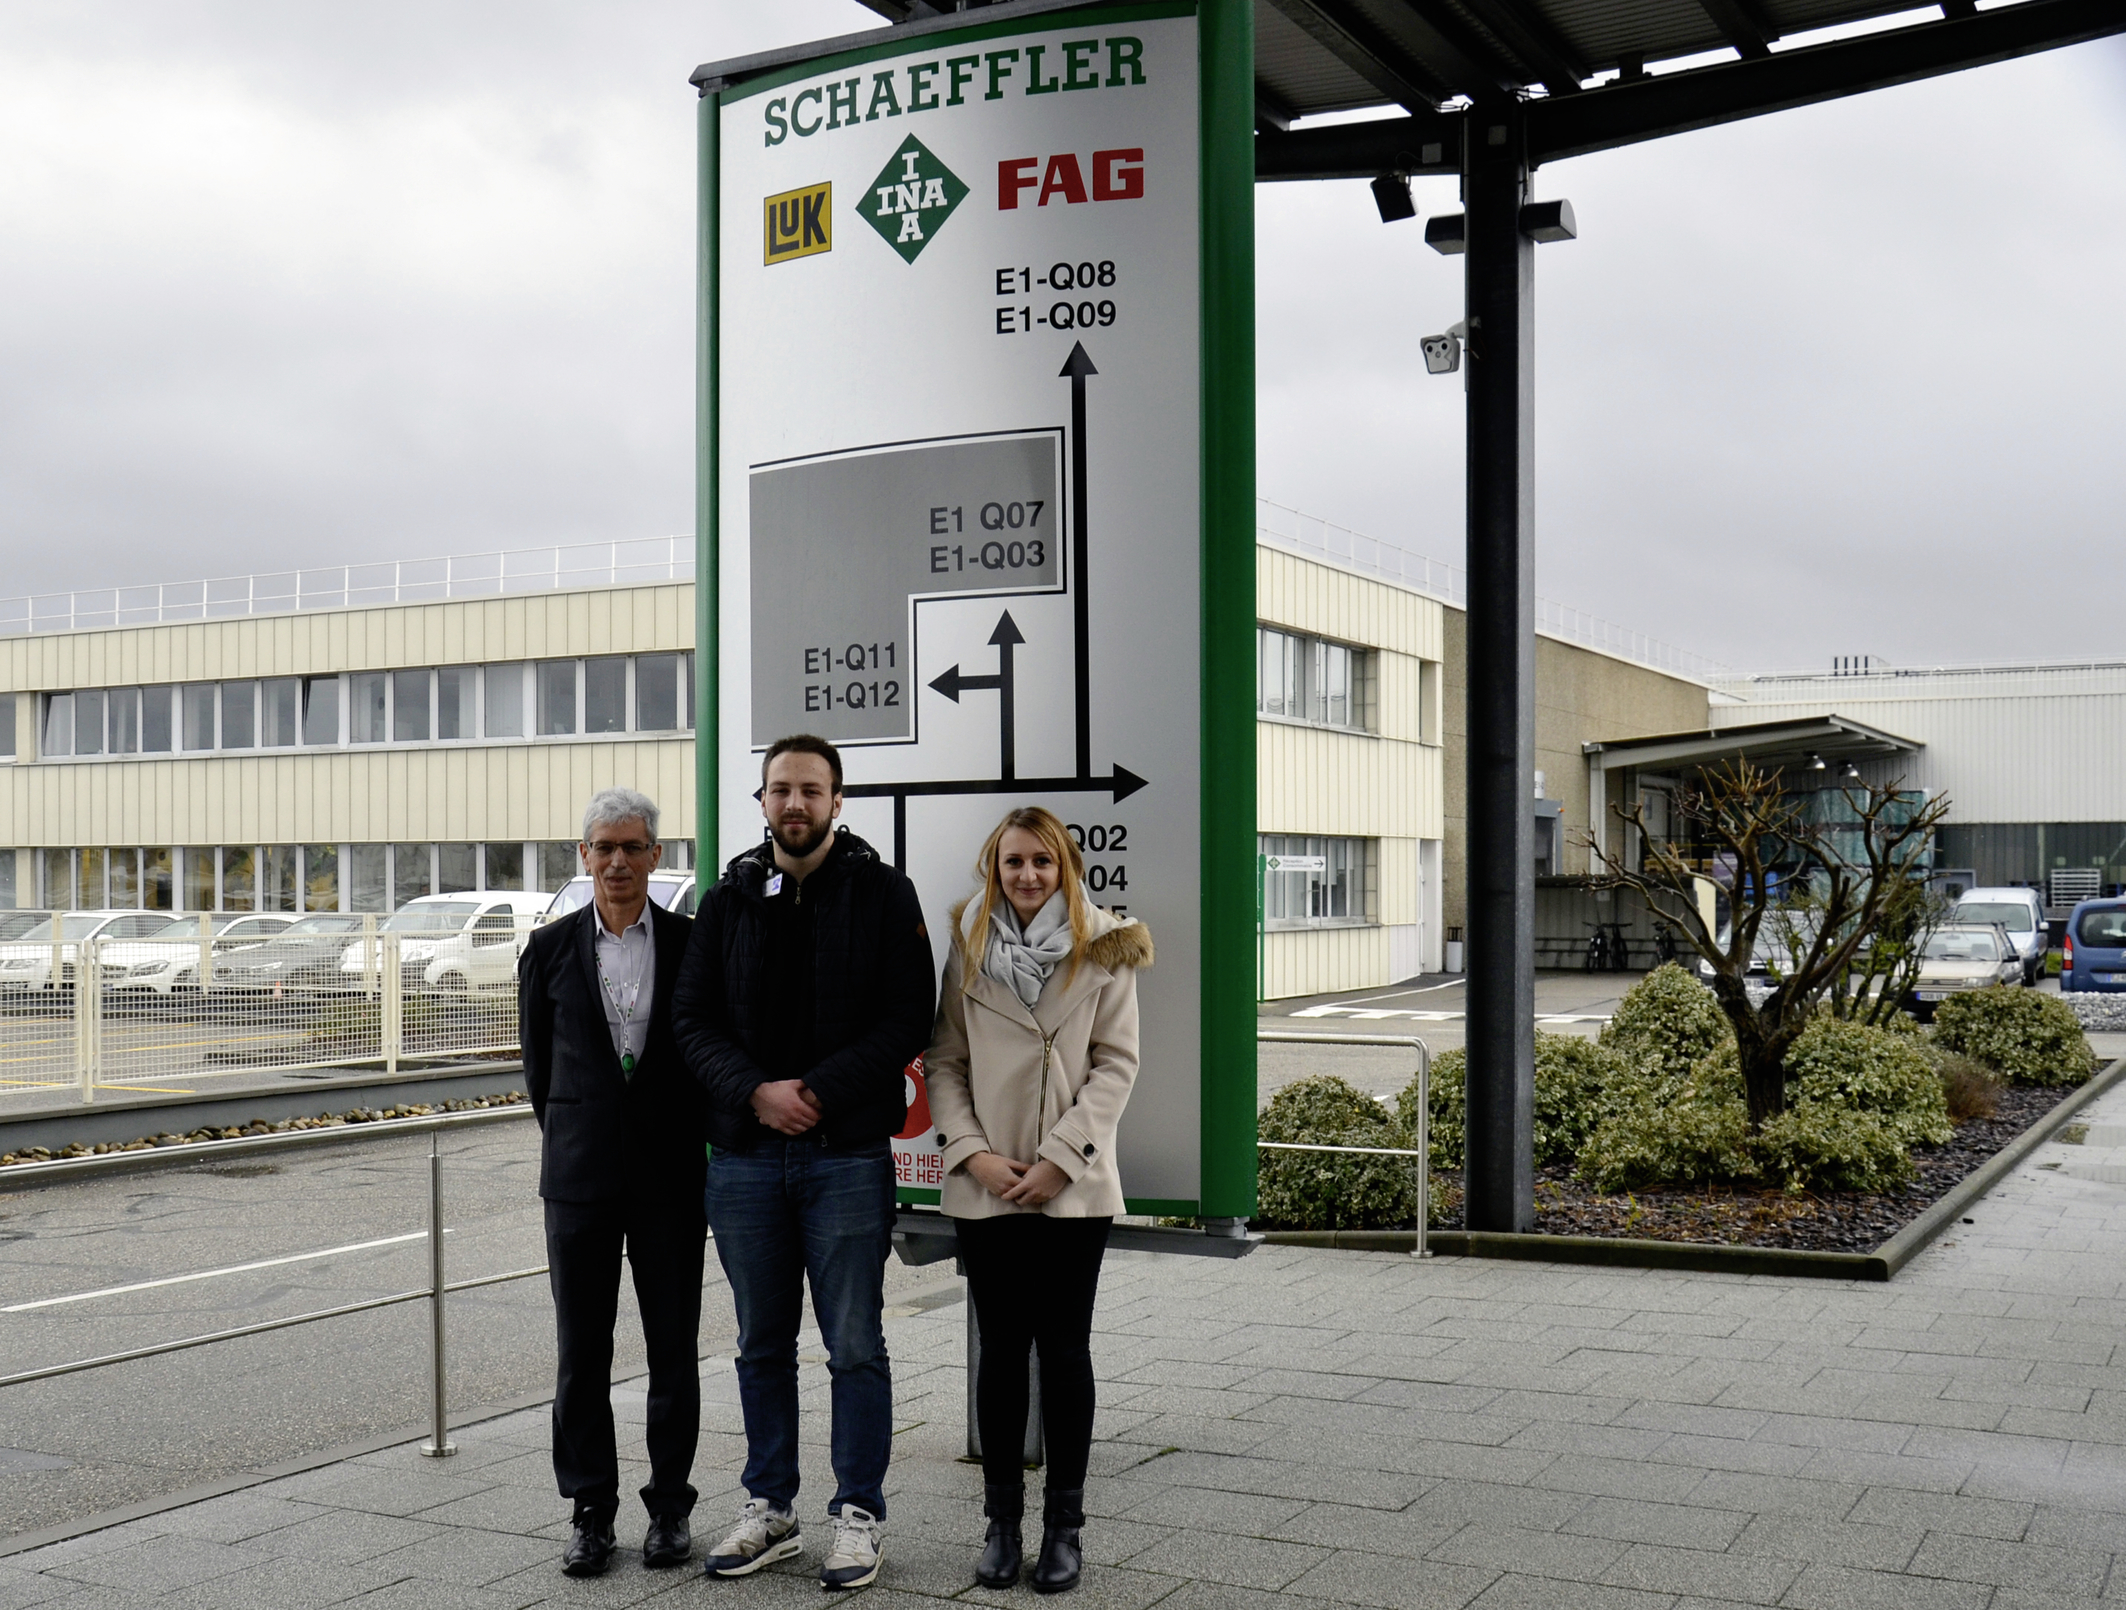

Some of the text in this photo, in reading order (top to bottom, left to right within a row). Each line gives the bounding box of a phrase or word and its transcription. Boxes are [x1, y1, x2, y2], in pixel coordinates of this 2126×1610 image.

[764, 36, 1147, 148] SCHAEFFLER
[998, 147, 1144, 210] FAG
[876, 177, 948, 216] INA
[996, 260, 1117, 295] E1-Q08
[996, 300, 1117, 335] E1-Q09
[930, 500, 1045, 535] E1 Q07
[930, 540, 1046, 573] E1-Q03
[804, 642, 896, 675] E1-Q11
[804, 680, 900, 712] E1-Q12
[1084, 864, 1129, 893] 04
